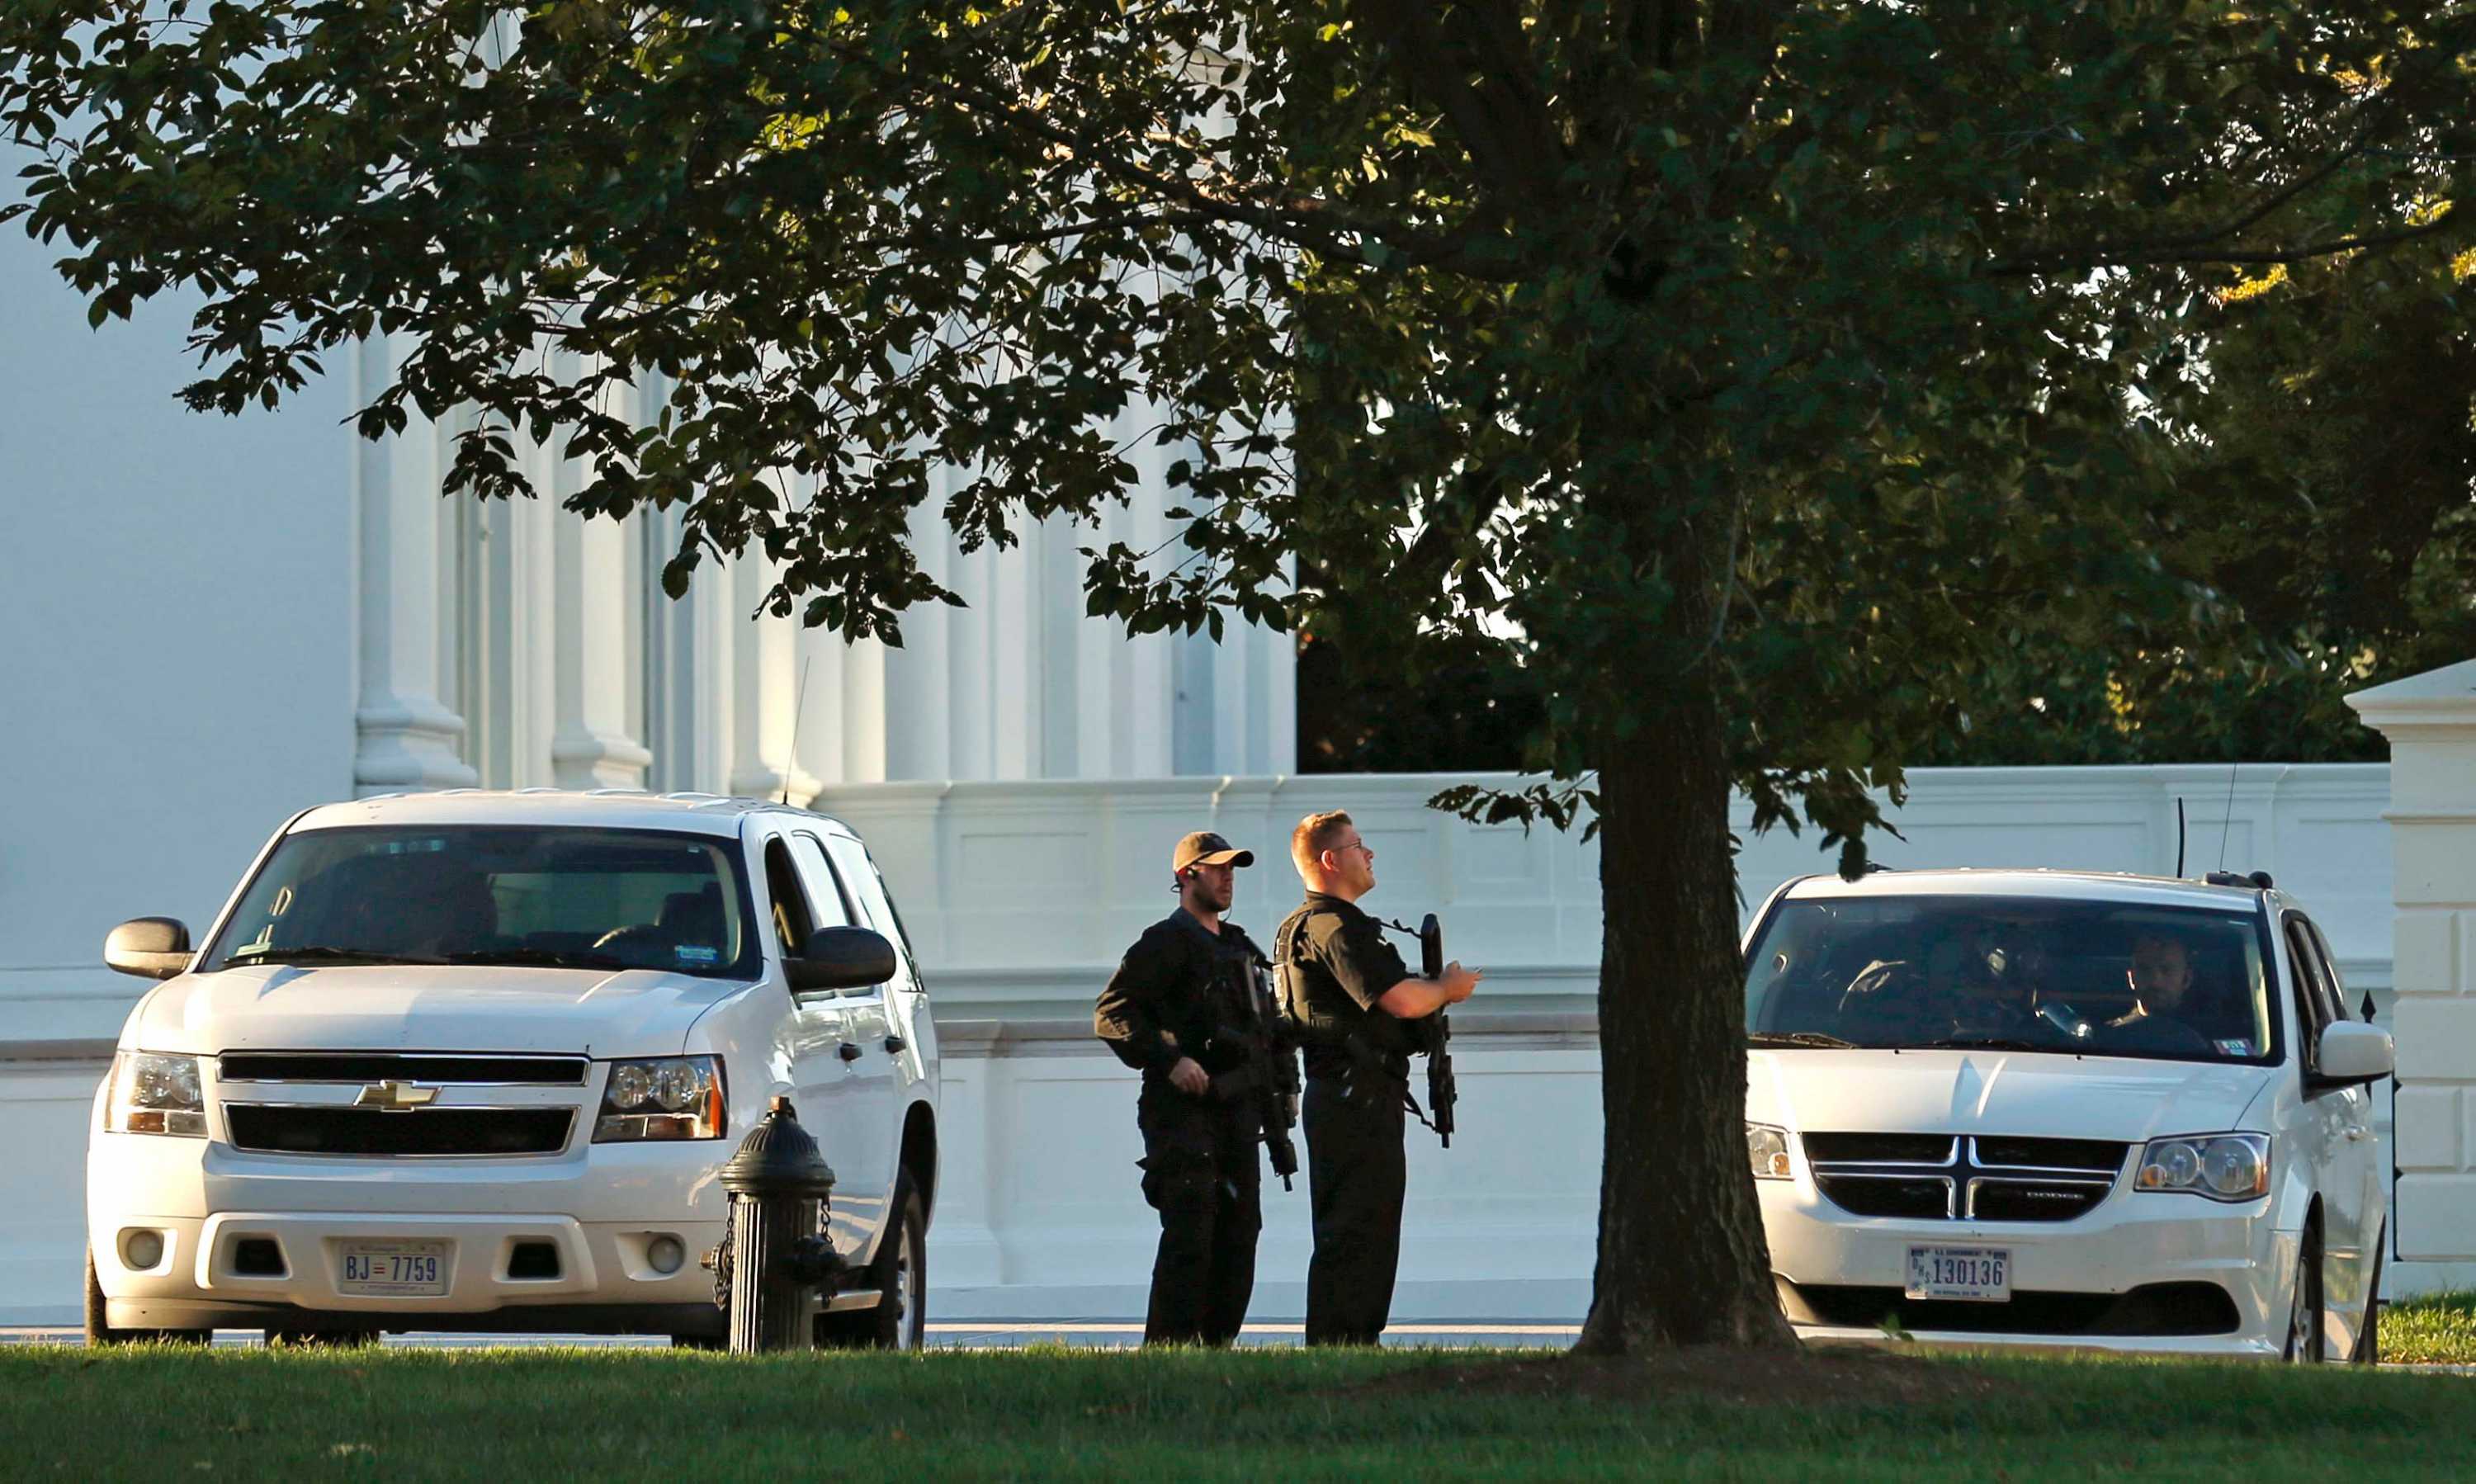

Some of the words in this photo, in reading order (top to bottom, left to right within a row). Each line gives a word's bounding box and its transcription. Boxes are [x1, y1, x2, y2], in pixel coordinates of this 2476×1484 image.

[347, 1255, 370, 1280] BJ
[390, 1256, 436, 1281] 7759
[1933, 1259, 2003, 1286] 130136
